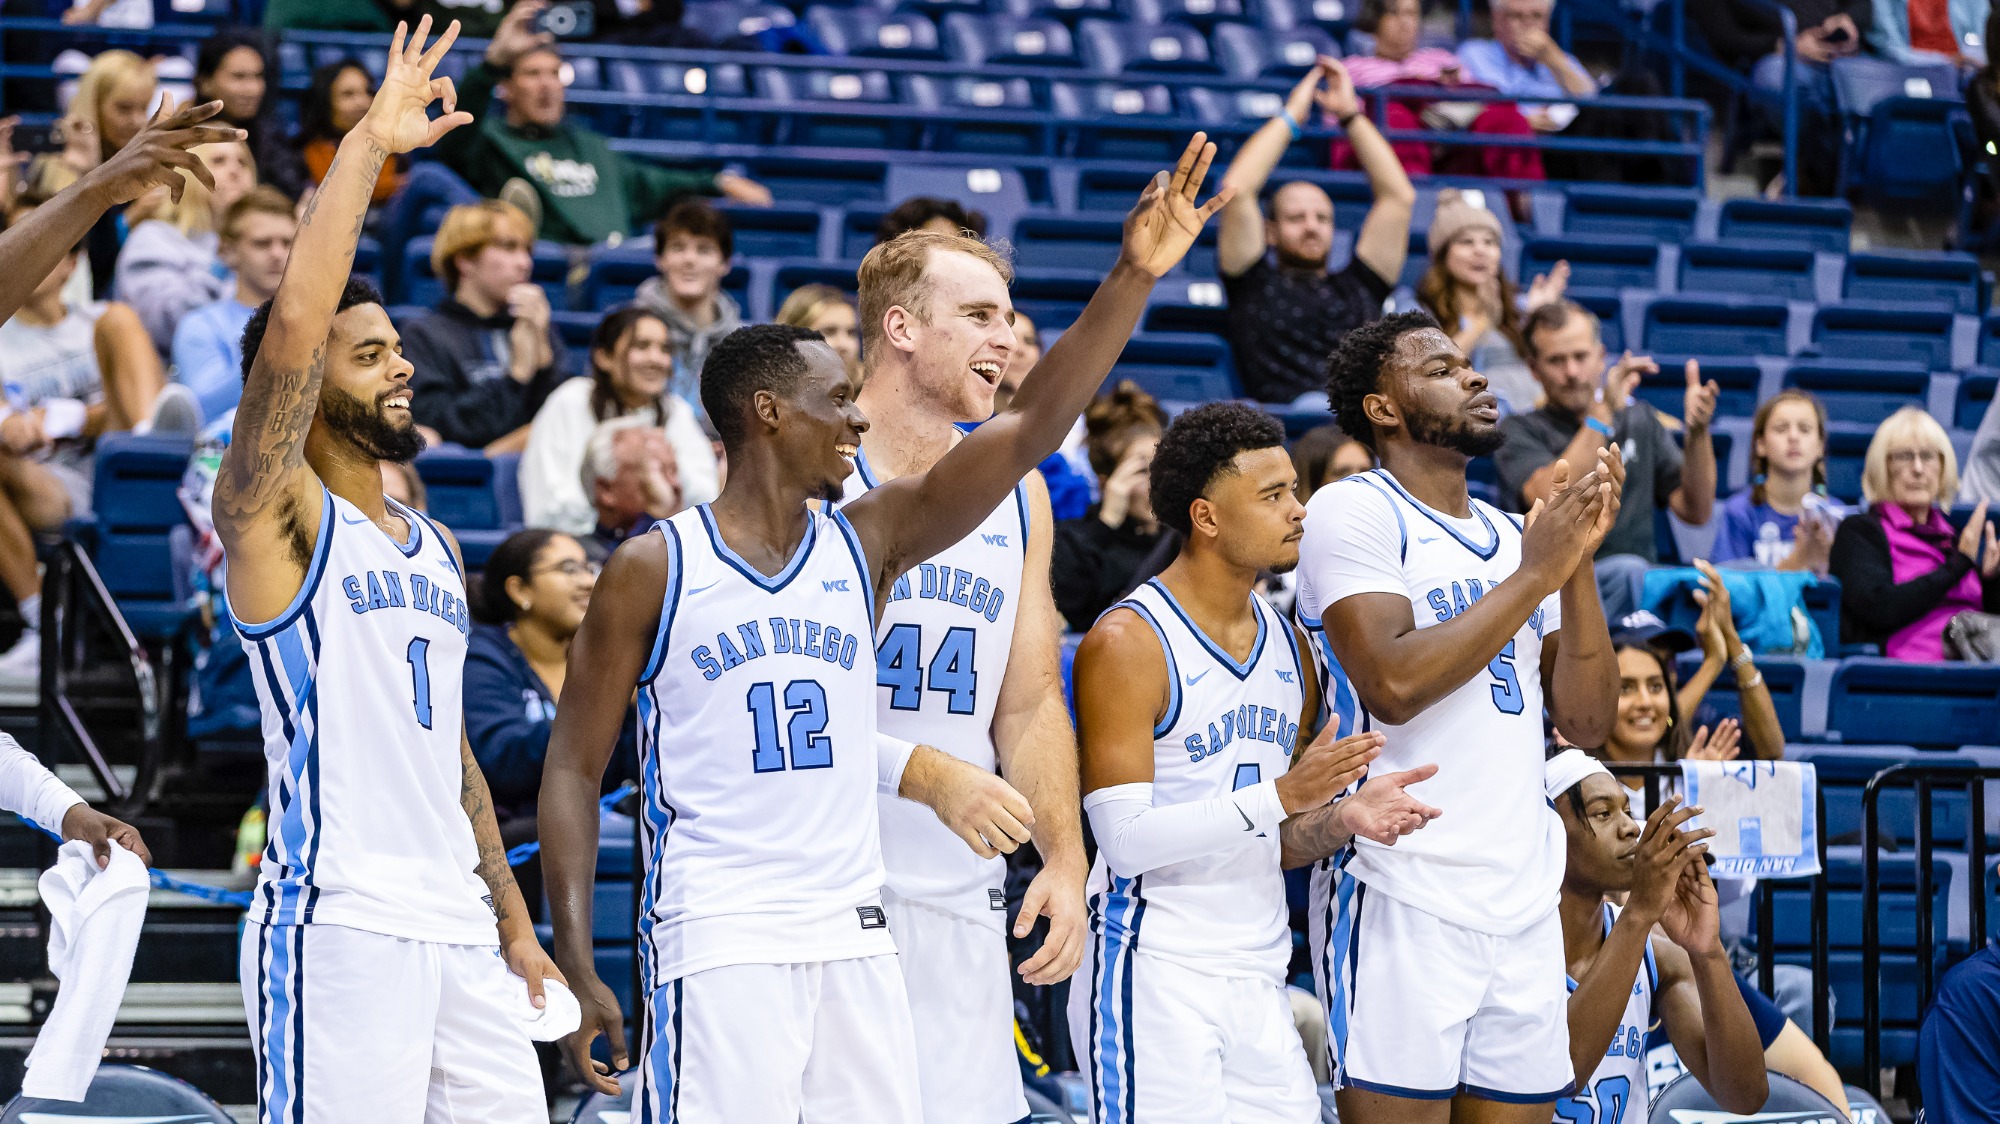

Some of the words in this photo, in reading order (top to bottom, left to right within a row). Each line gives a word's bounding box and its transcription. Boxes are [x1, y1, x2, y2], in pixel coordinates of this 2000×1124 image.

[981, 533, 1009, 548] WCC
[342, 570, 406, 615] SAN
[821, 579, 850, 593] WCC
[919, 563, 1004, 623] DIEGO
[1426, 578, 1484, 623] SAN
[691, 620, 766, 681] SAN
[768, 617, 858, 671] DIEGO
[877, 623, 977, 716] 44
[1487, 638, 1525, 716] 5
[406, 635, 432, 731] 1
[747, 679, 833, 774] 12
[1184, 709, 1236, 763] SAN
